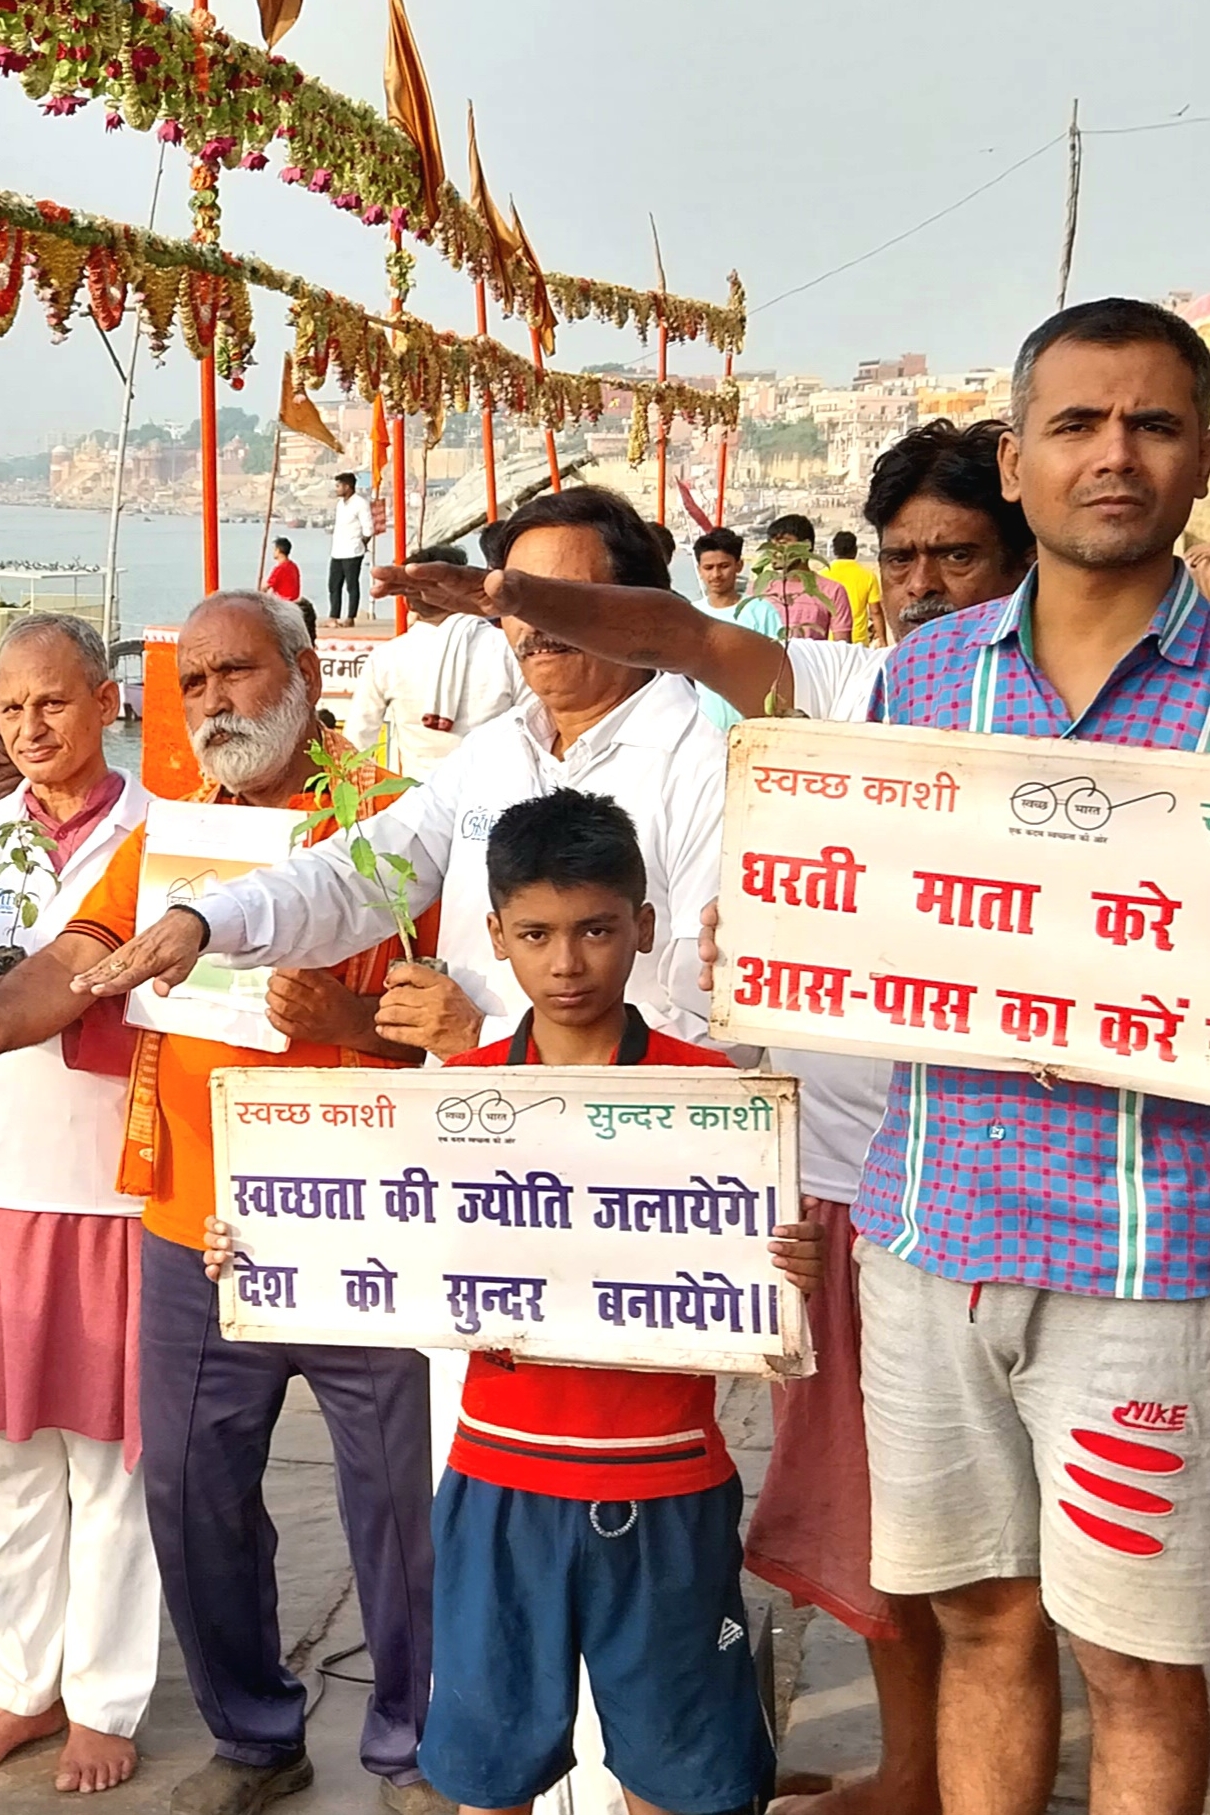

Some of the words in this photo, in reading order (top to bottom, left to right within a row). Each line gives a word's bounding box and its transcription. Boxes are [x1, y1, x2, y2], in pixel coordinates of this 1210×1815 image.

[752, 766, 850, 800] स्वच्छ
[863, 772, 960, 813] काशी
[1074, 804, 1101, 815] भारत
[742, 846, 866, 913] धरती
[913, 871, 1041, 935] माता
[1091, 880, 1182, 951] करे
[734, 956, 977, 1034] आस-पास
[996, 989, 1075, 1047] का
[1094, 994, 1190, 1062] करें
[235, 1104, 311, 1129] स्वच्छ
[321, 1094, 395, 1129] काशी
[585, 1103, 674, 1141] सुन्दर
[687, 1096, 772, 1132] काशी
[231, 1174, 366, 1220] स्वच्छता
[380, 1167, 438, 1224] की
[452, 1170, 573, 1230] ज्योति
[232, 1251, 298, 1309] देश
[341, 1257, 397, 1313] को
[443, 1272, 547, 1333] सुन्दर
[1124, 1400, 1189, 1426] NIKE
